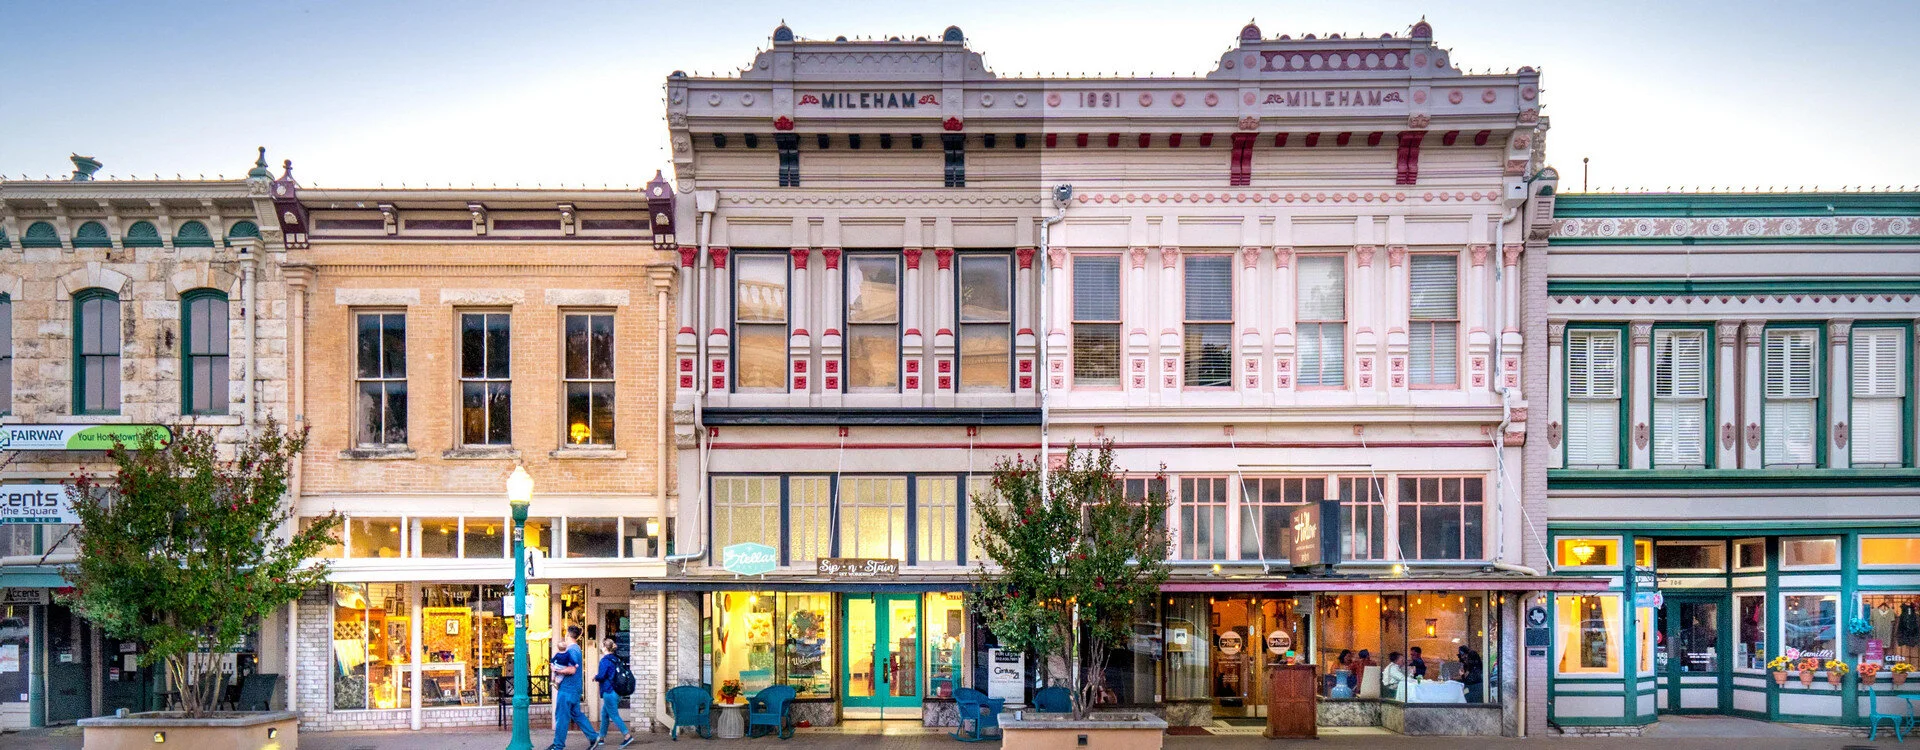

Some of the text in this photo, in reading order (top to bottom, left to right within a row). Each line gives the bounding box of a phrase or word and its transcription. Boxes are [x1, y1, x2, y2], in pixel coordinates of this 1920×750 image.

[821, 92, 916, 109] MILEHAM
[1079, 92, 1120, 108] 1891
[1286, 90, 1382, 107] MILEHAM
[11, 429, 64, 441] FAIRWAY
[77, 432, 95, 441] Your
[4, 507, 58, 517] the Square
[820, 559, 840, 574] Sip
[864, 559, 897, 575] Stain
[1800, 649, 1835, 659] Camille's
